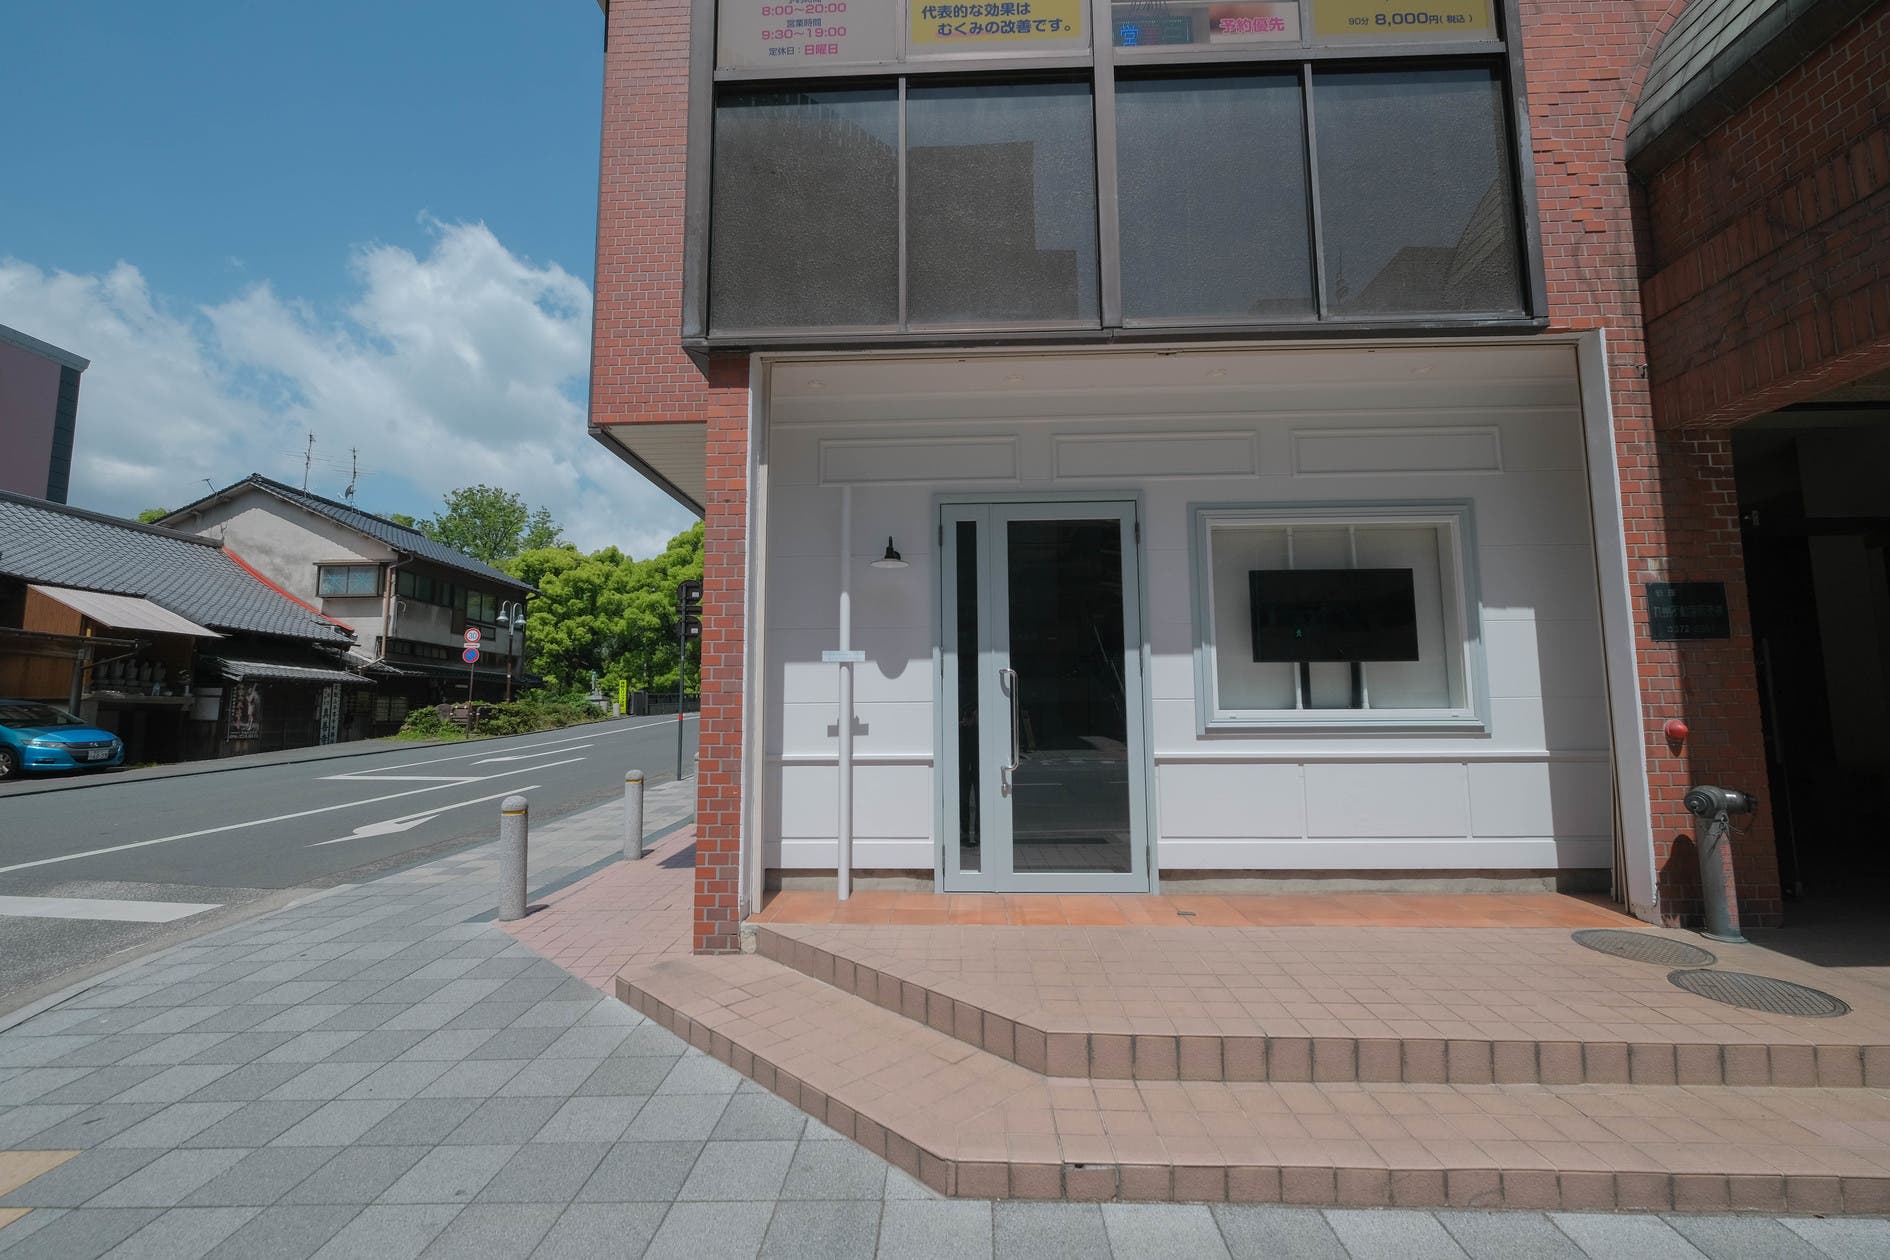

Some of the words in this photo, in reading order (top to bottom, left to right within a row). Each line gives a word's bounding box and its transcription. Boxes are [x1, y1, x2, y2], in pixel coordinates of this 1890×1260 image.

[921, 2, 1031, 20] 代表的な効果は
[787, 18, 822, 28] 営業時間
[937, 18, 1071, 36] むくみの改善です。
[1219, 16, 1285, 33] 予約優先
